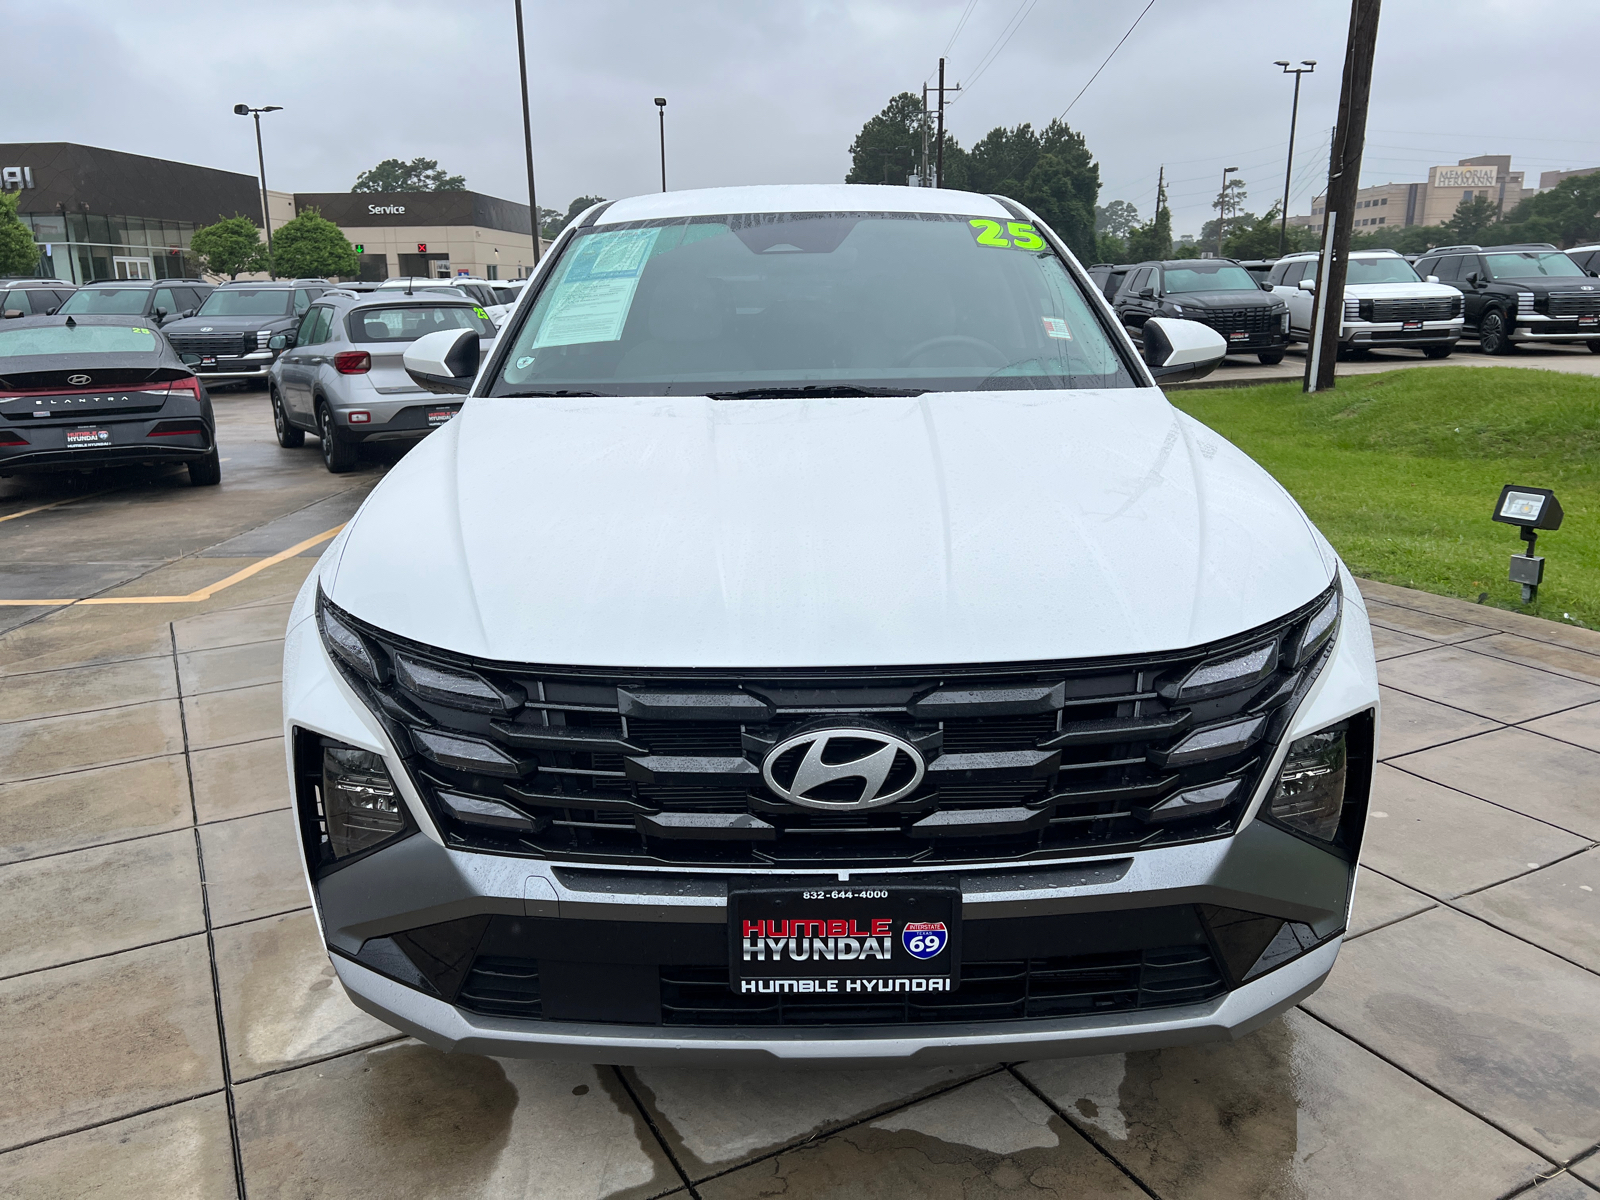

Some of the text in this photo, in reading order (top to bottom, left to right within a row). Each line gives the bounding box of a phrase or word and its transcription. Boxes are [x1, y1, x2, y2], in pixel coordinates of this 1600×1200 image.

[1440, 169, 1494, 179] MEMORIAL
[1438, 178, 1494, 186] HERMANN
[368, 204, 406, 214] Service
[968, 219, 1047, 252] 25
[473, 307, 489, 320] 25
[36, 396, 129, 405] ELANTRA
[803, 890, 889, 900] 832-644-4000
[742, 918, 893, 938] HUMBLE
[742, 937, 892, 961] HYUNDAI
[909, 935, 940, 953] 69
[741, 978, 951, 994] HUMBLE HYUNDAI
